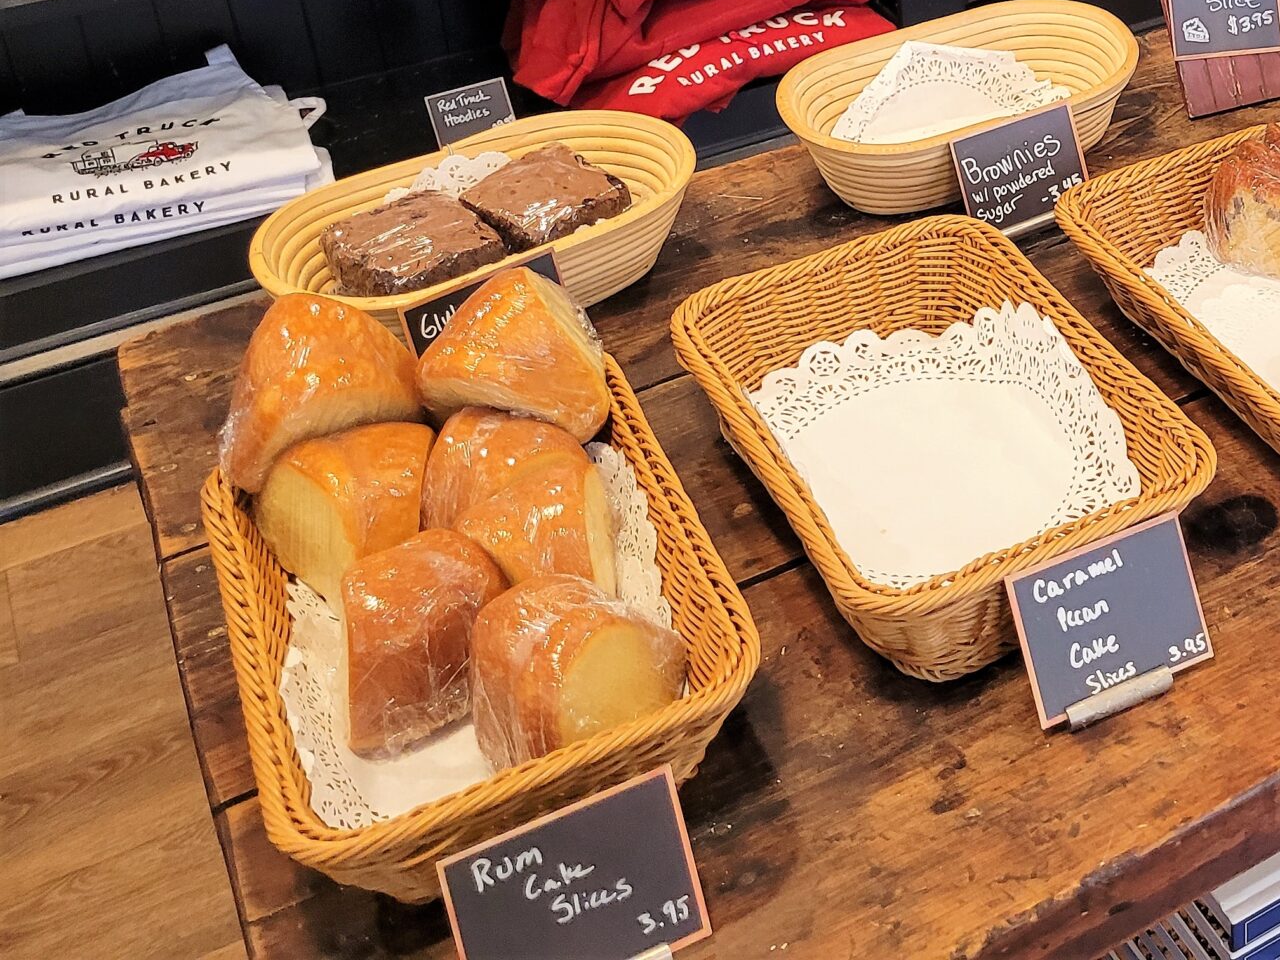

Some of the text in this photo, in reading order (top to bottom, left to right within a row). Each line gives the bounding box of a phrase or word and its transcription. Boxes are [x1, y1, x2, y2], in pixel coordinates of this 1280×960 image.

[1227, 9, 1274, 35] $3.95
[676, 31, 825, 87] RURAL BAKERY
[437, 90, 491, 113] Red Truck
[444, 108, 490, 128] Hoodies
[961, 134, 1061, 185] Brownies
[52, 161, 232, 204] RURAL BAKERY
[972, 159, 1055, 204] w/ powdered
[976, 194, 1023, 223] sugar
[1033, 549, 1124, 604] Caramel
[1057, 599, 1110, 633] Pecan
[1069, 635, 1120, 669] Cake
[1168, 633, 1206, 662] 3.95
[1085, 661, 1137, 695] Slices
[471, 846, 543, 894] Rum
[525, 862, 595, 900] Cake
[551, 878, 633, 924] Slices
[636, 895, 690, 935] 3.95
